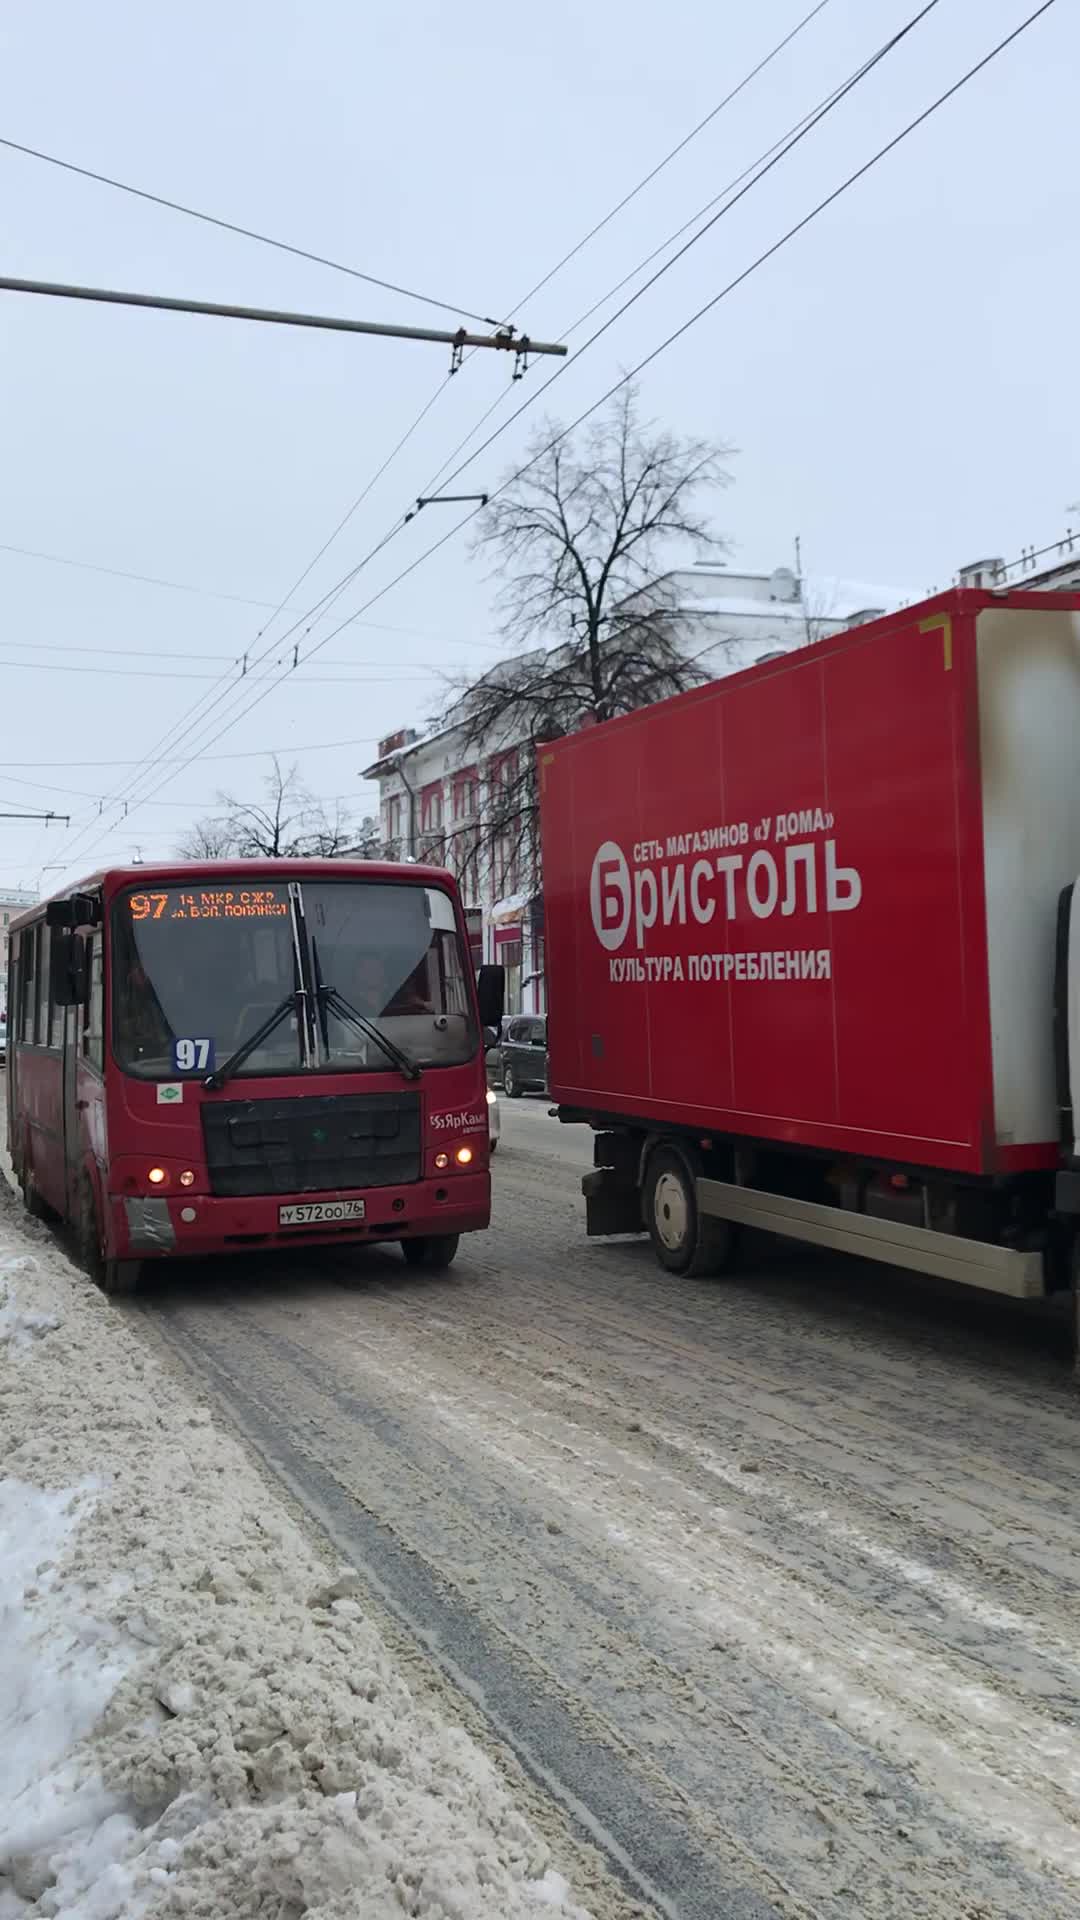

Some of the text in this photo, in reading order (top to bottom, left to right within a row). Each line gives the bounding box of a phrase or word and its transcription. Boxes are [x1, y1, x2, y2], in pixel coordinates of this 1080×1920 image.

[633, 840, 663, 863] СЕТЬ
[666, 822, 748, 857] МАГАЗИНОВ
[776, 807, 834, 842] ДОМА»
[130, 894, 168, 919] 97
[201, 892, 234, 905] МКР
[609, 949, 831, 983] КУЛЬТУРА ПОТРЕБЛЕНИЯ
[176, 1039, 209, 1070] 97
